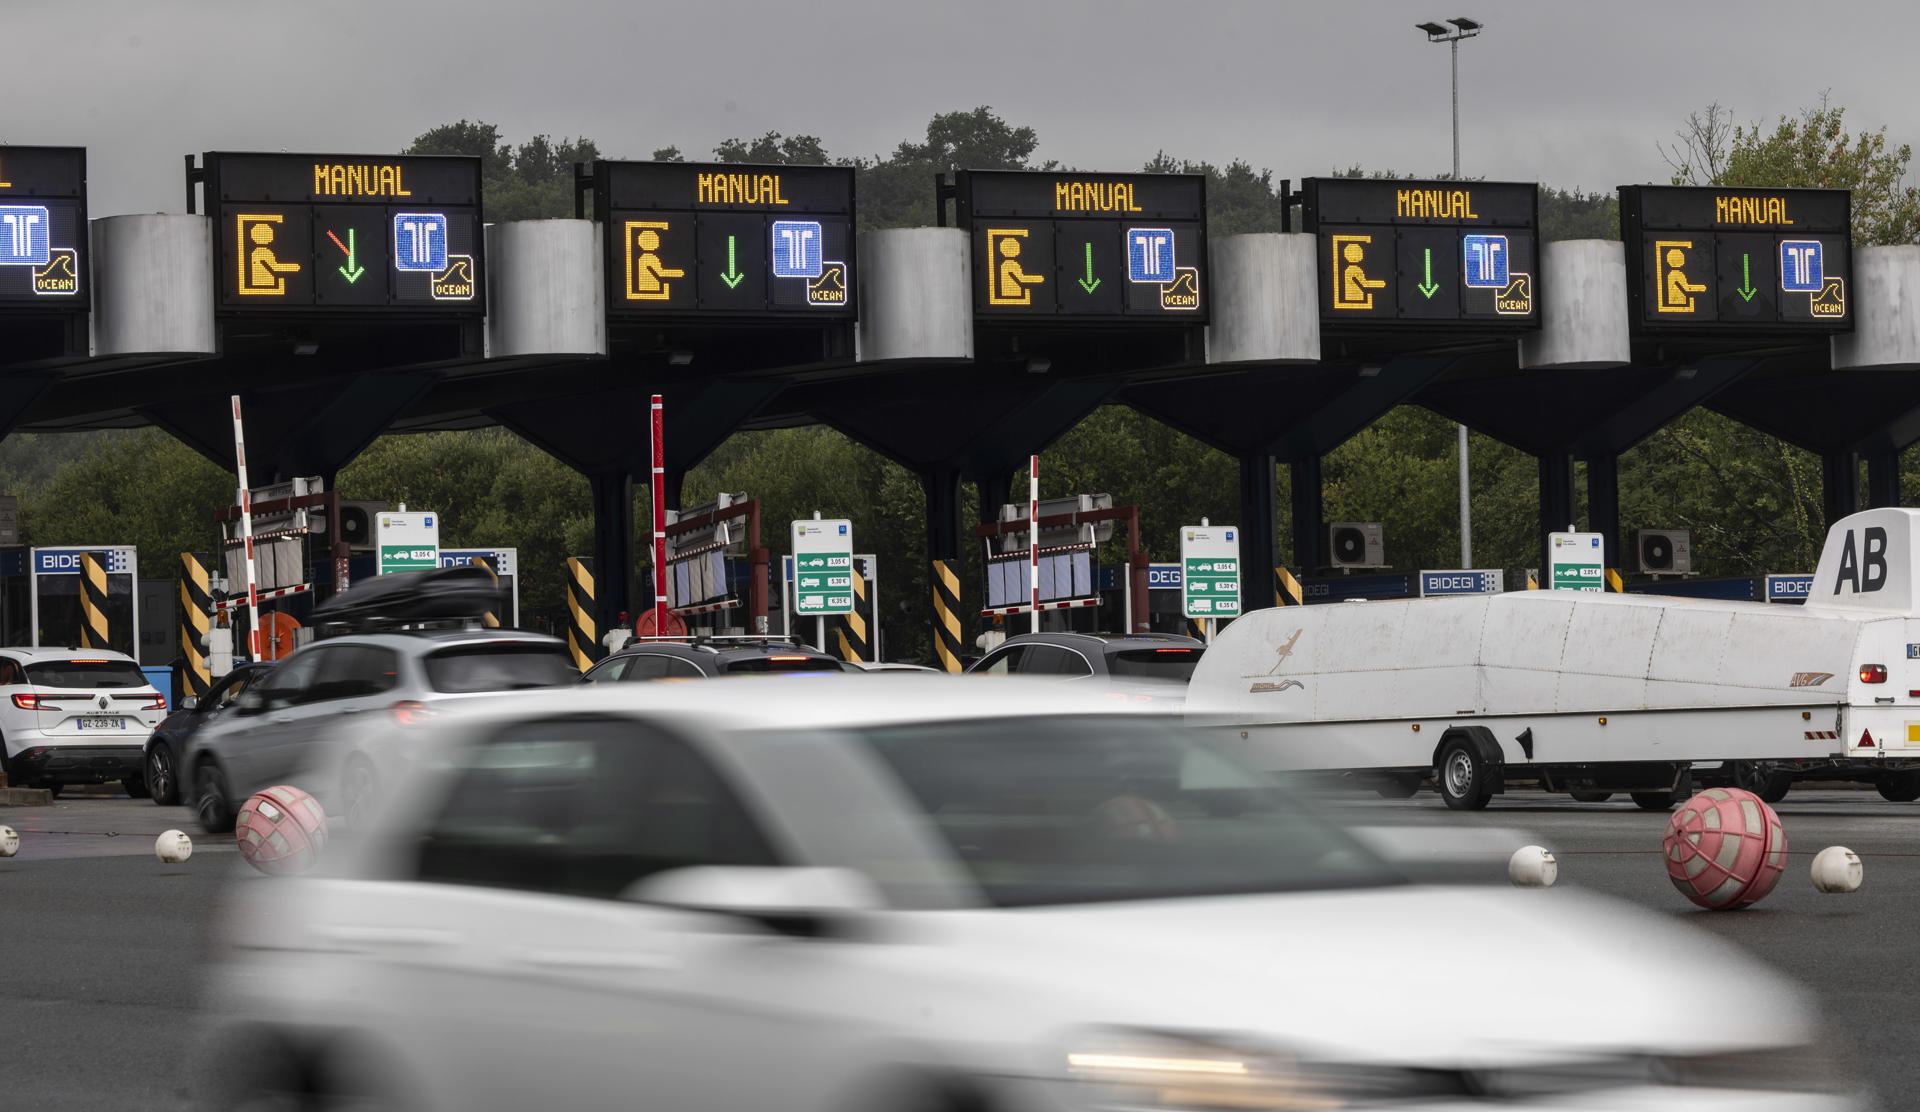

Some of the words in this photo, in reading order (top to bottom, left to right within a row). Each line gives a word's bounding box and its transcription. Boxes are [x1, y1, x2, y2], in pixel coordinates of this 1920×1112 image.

[314, 164, 411, 196] MANUAL
[698, 173, 788, 204] MANUAL
[1056, 182, 1142, 212] MANUAL
[1397, 189, 1478, 218] MANUAL
[1716, 197, 1793, 224] MANUAL
[37, 279, 74, 290] OCEAN
[436, 284, 470, 295] OCEAN
[811, 290, 843, 301] OCEAN
[1165, 295, 1195, 306] OCEAN
[1499, 300, 1528, 310] OCEAN
[1814, 303, 1842, 313] OCEAN
[43, 555, 80, 568] BIDE
[1834, 526, 1888, 596] AB
[1149, 571, 1181, 583] DEG
[1429, 577, 1474, 589] BIDEGI
[1304, 584, 1329, 596] IDEGI
